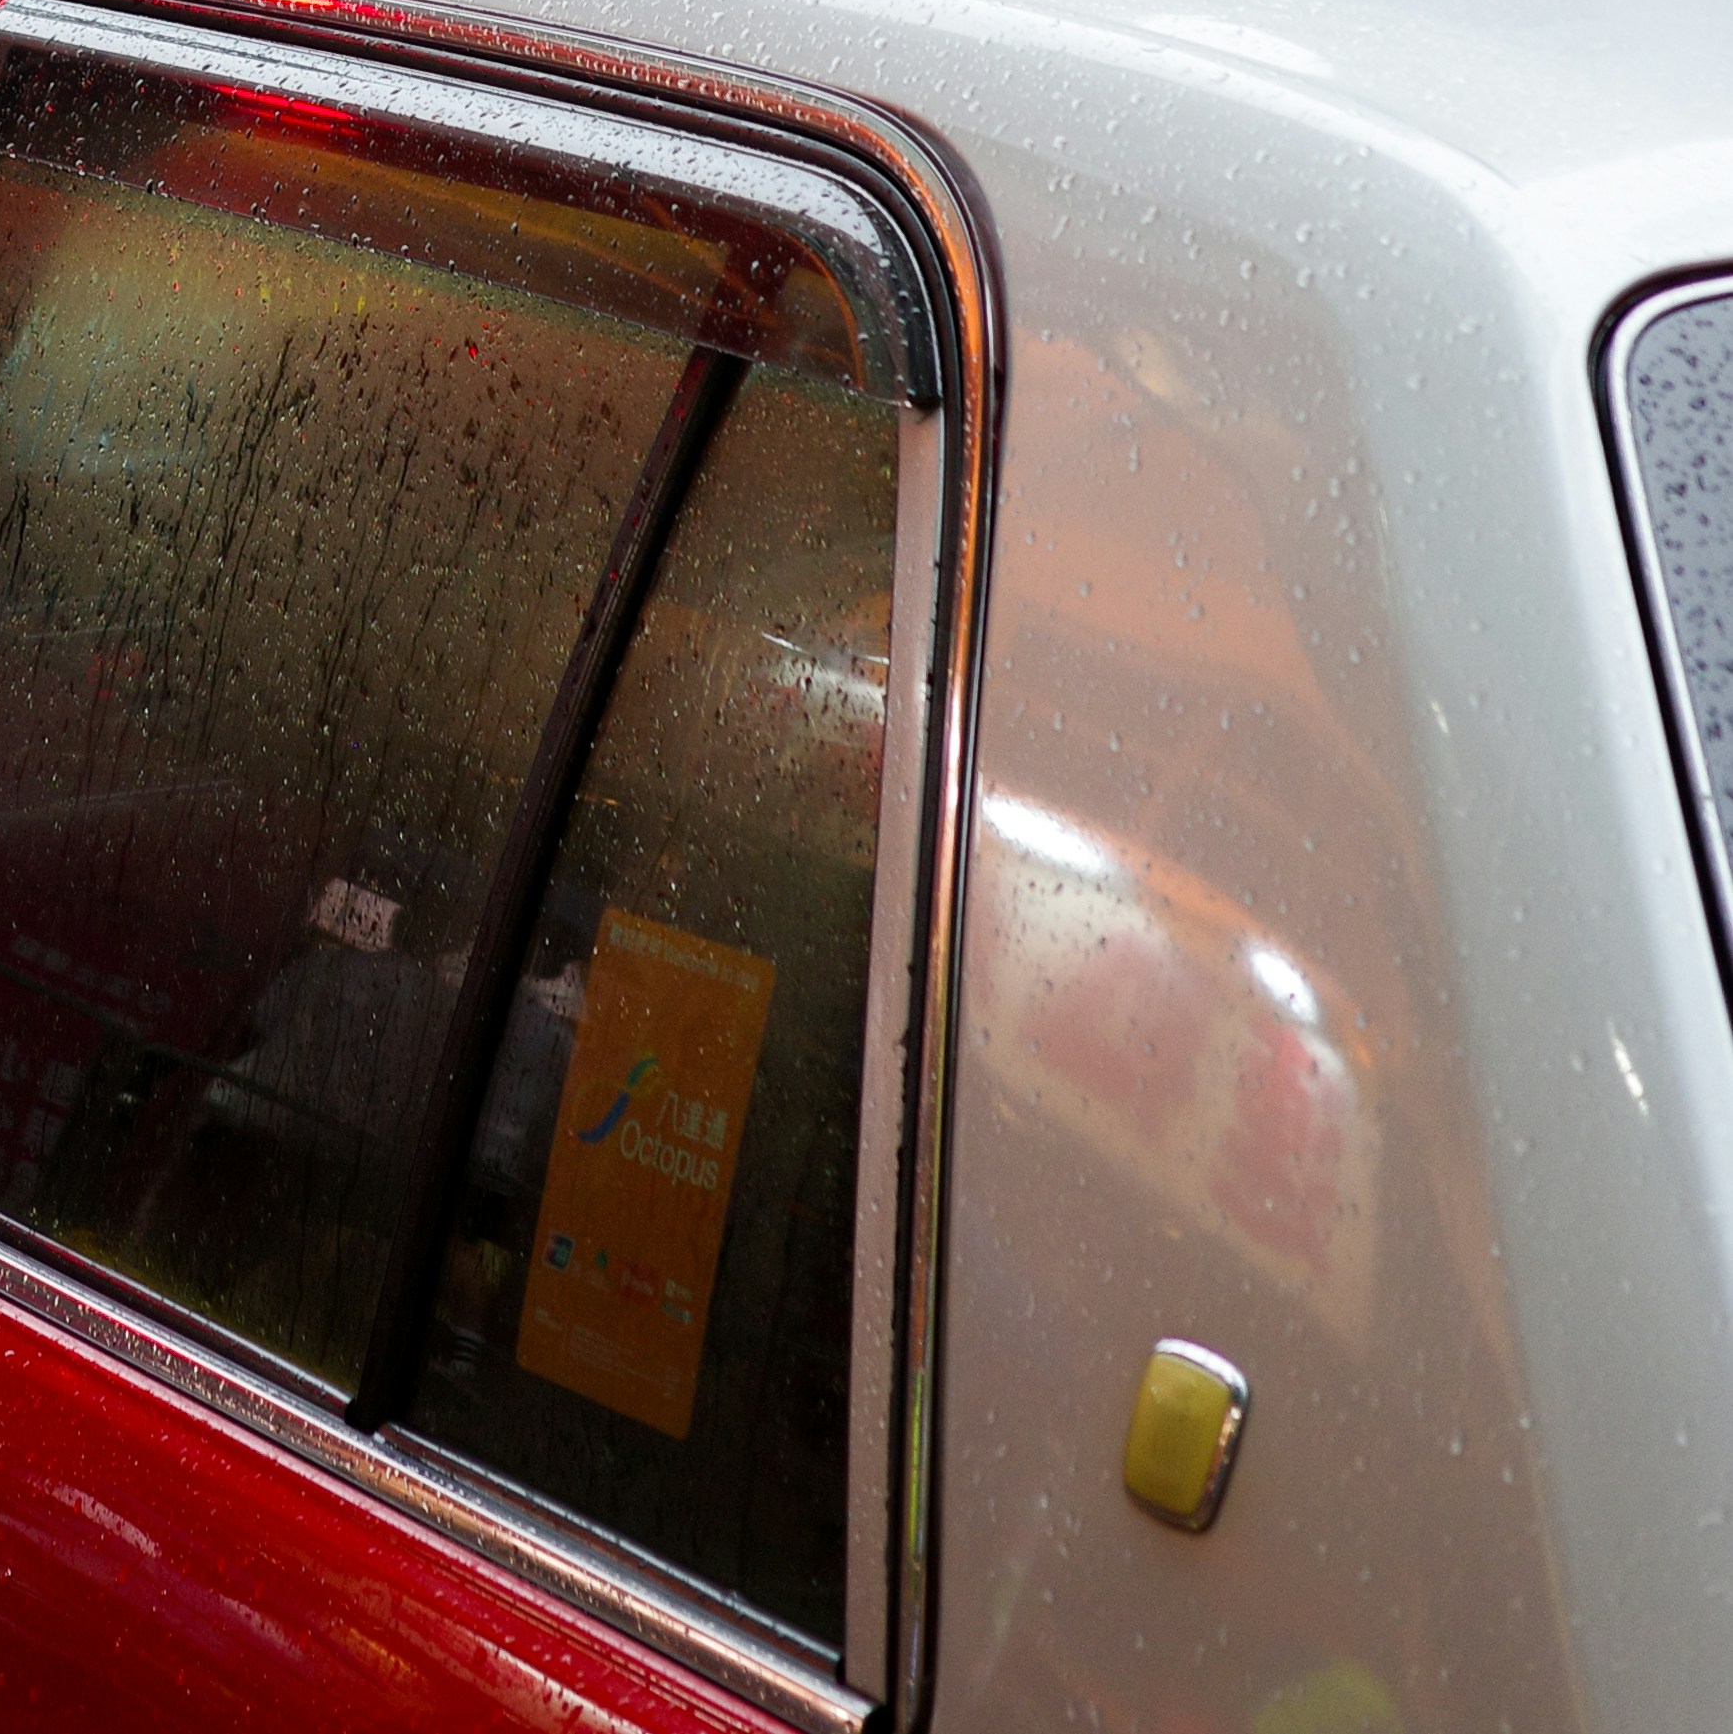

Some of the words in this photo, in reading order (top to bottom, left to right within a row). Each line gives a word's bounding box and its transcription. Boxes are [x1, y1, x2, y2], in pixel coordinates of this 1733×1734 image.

[656, 1089, 728, 1151] 八達通
[620, 1119, 719, 1191] Octopus
